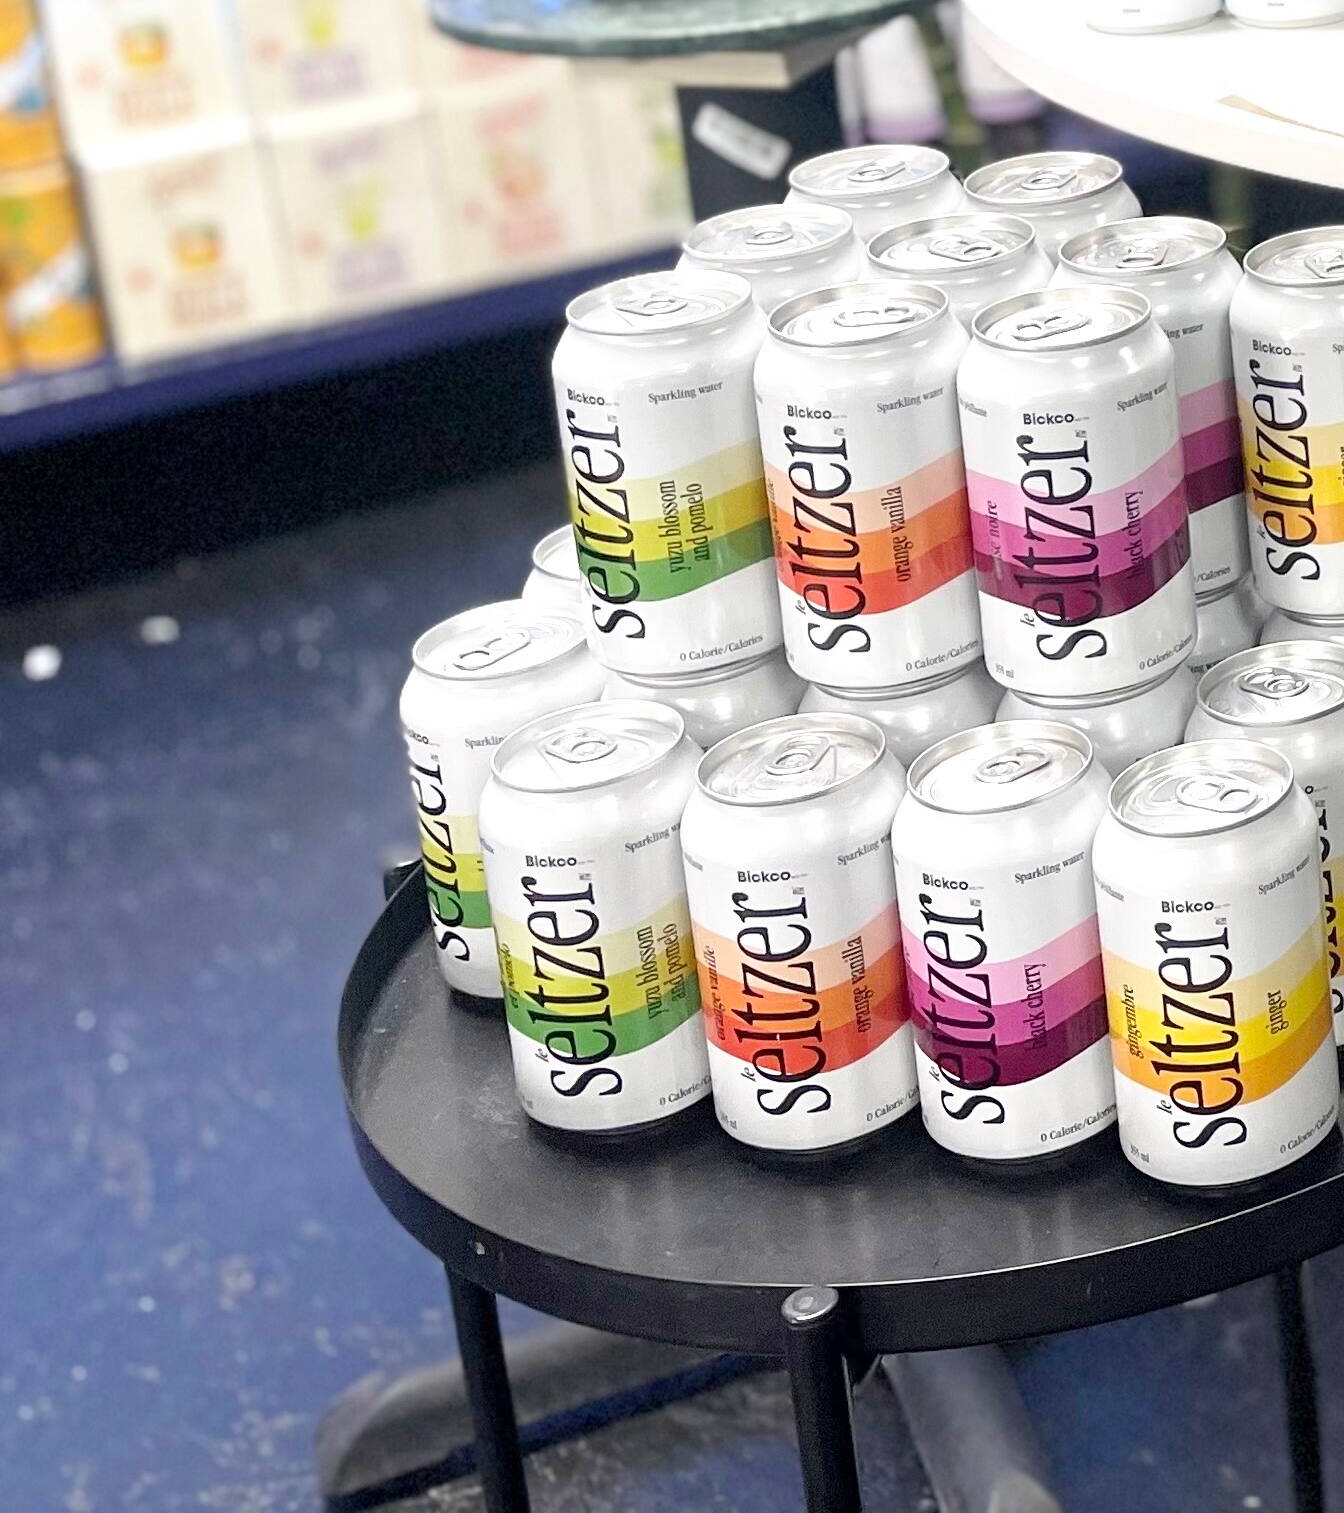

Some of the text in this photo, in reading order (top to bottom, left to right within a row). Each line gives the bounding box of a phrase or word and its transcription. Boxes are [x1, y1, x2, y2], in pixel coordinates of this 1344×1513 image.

[648, 386, 696, 404] Sparkling
[877, 394, 920, 413] Sparkling
[1249, 359, 1320, 580] seltzer
[565, 408, 645, 638] seltzer
[659, 480, 685, 573] yuzu blossom
[687, 483, 713, 560] and pomelo
[784, 425, 871, 652] seltzer
[887, 487, 914, 582] orange vanilla
[1012, 434, 1107, 660] seltzer
[1122, 489, 1143, 536] cherry
[1020, 613, 1035, 627] le
[625, 828, 669, 853] Sparkling
[837, 841, 879, 865] Sparkling
[1015, 864, 1060, 883] Sparkling
[520, 875, 623, 1097] seltzer
[636, 926, 665, 1020] yuzu blossom
[732, 893, 831, 1115] seltzer
[842, 935, 874, 1033] orange vanilla
[918, 892, 1005, 1124] seltzer
[1023, 964, 1046, 1006] cherry
[1266, 990, 1287, 1035] ginger
[1121, 984, 1145, 1060] gingembre
[1149, 922, 1248, 1149] seltzer
[1156, 1099, 1172, 1115] le
